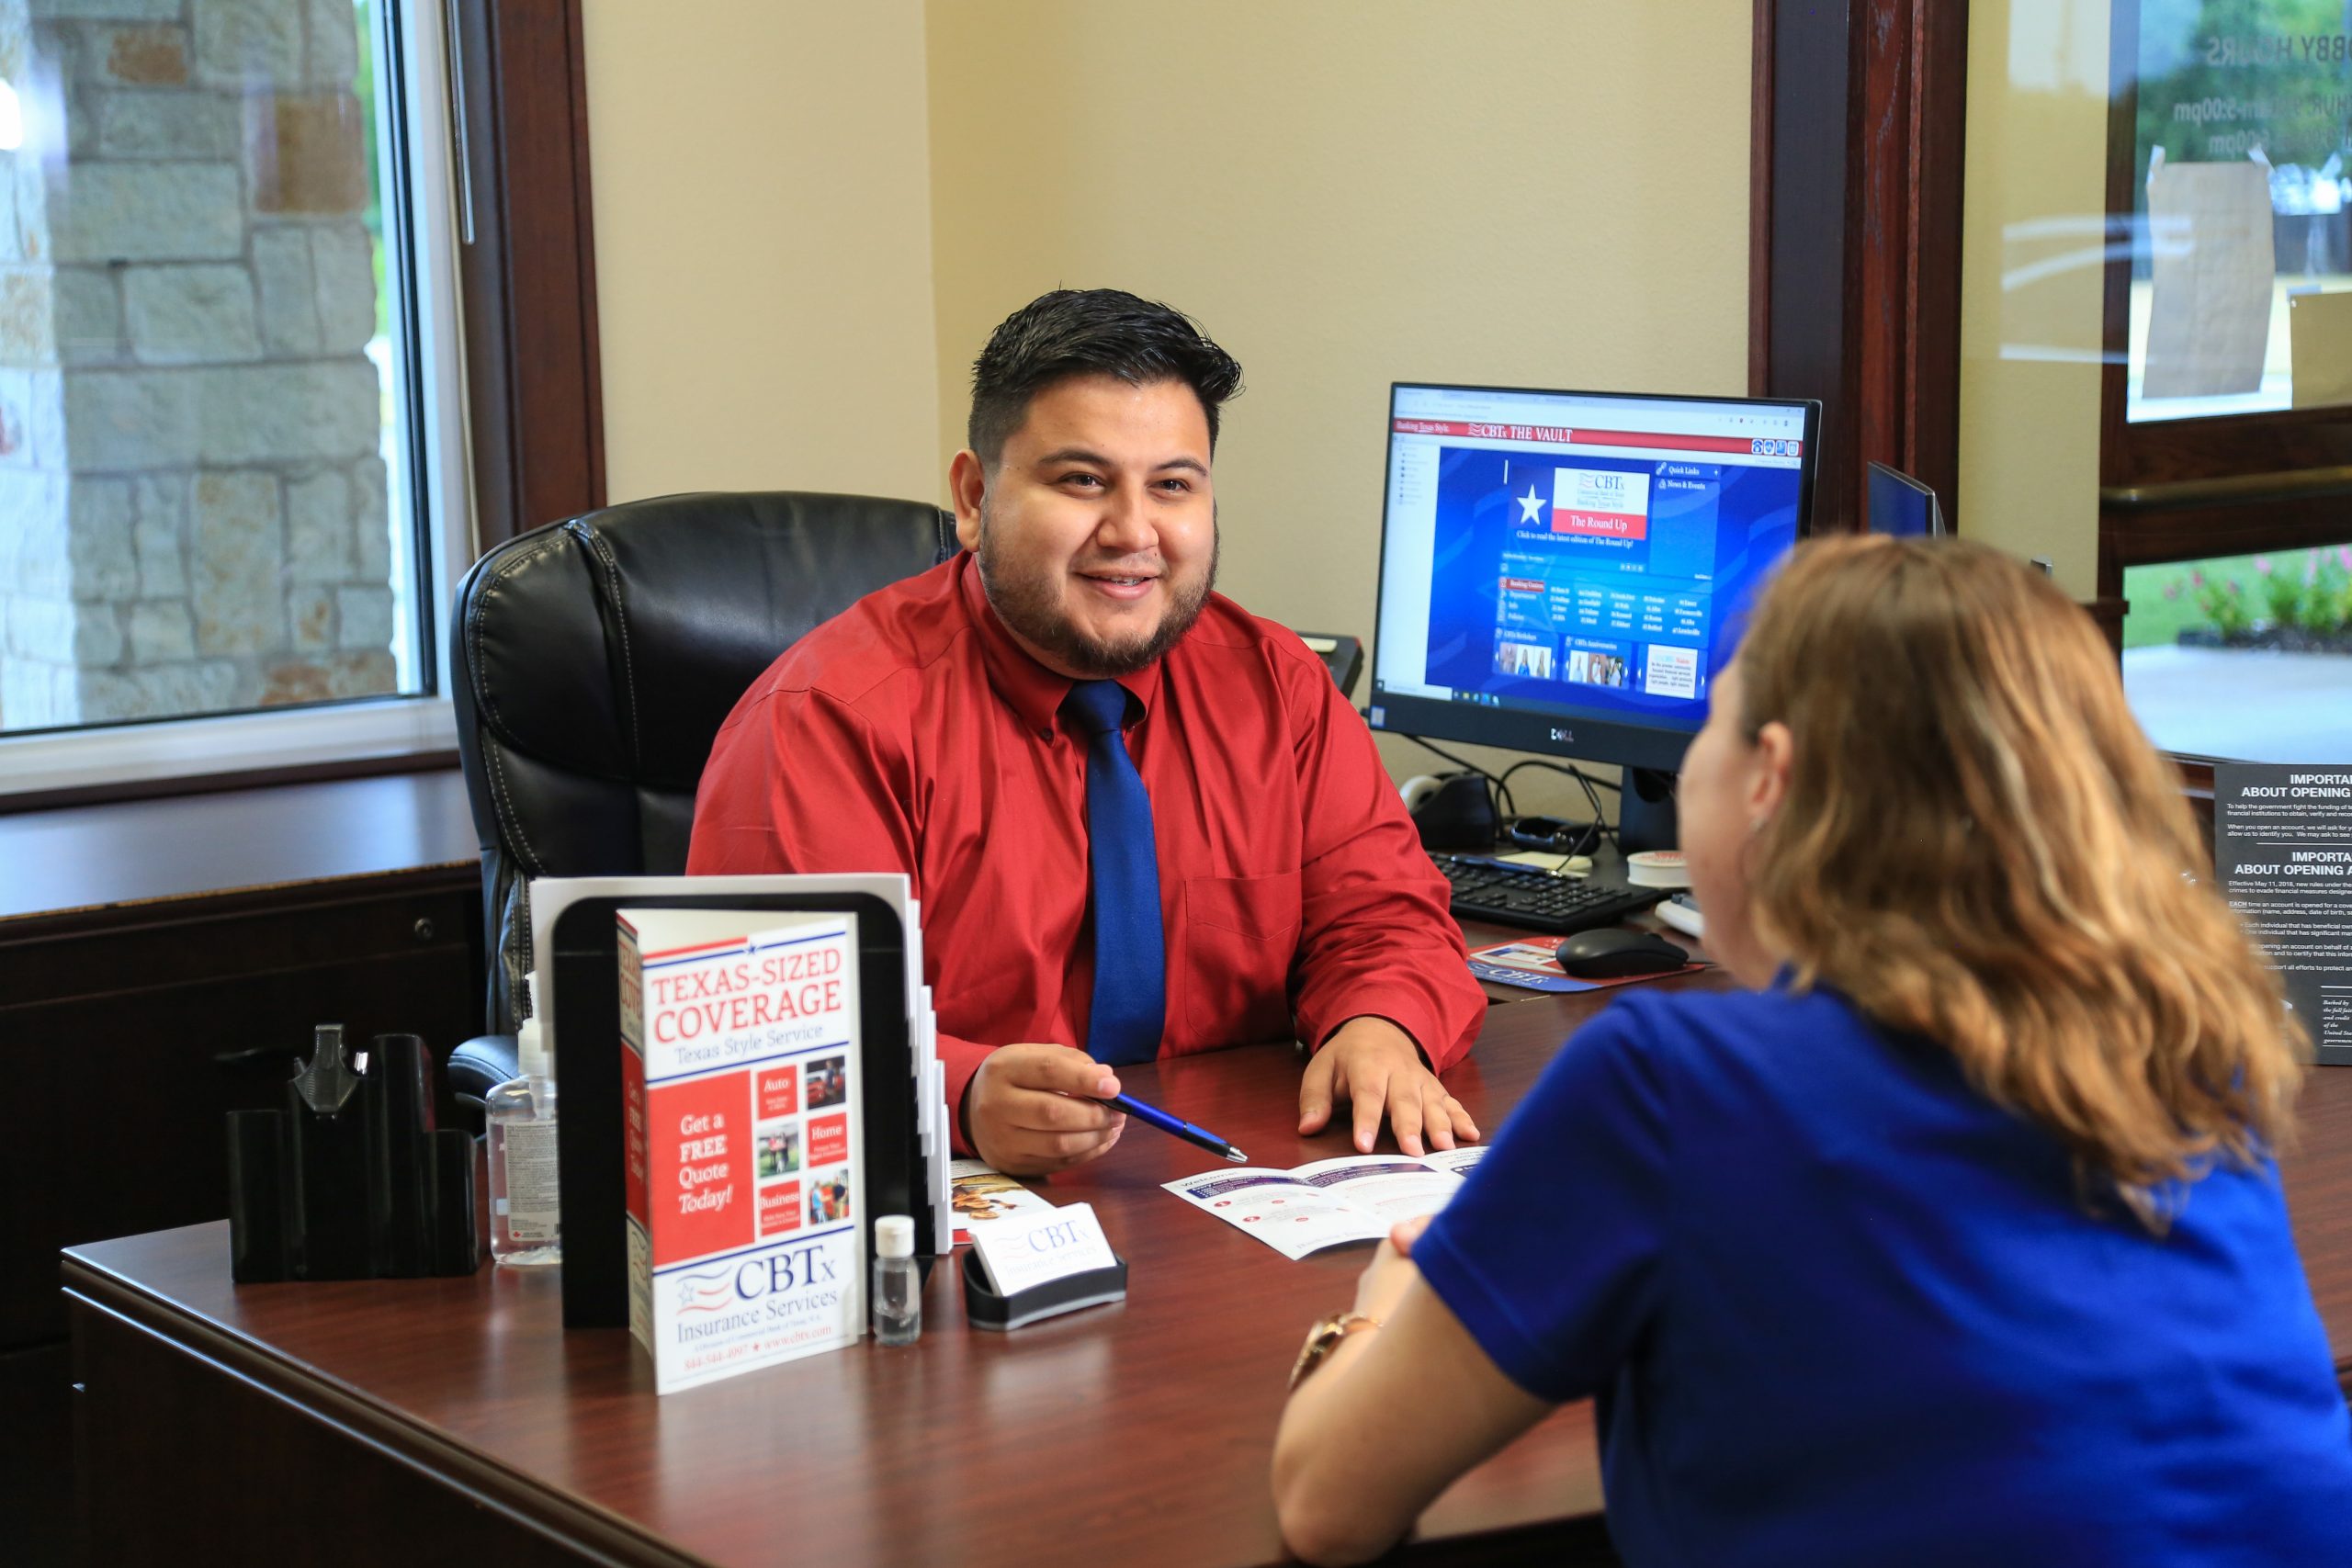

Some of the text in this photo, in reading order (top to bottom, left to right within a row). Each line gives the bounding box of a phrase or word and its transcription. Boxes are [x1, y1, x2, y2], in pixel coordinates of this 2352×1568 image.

[1510, 425, 1533, 441] THE
[1535, 427, 1573, 443] VAULT
[1668, 466, 1700, 476] Quick Links
[1668, 479, 1681, 489] News
[1688, 482, 1706, 491] Events
[1570, 514, 1628, 534] The Round Up
[1517, 530, 1529, 539] Click
[1530, 532, 1536, 540] to
[1537, 532, 1548, 541] read
[1571, 535, 1588, 544] edition
[1589, 536, 1594, 545] of
[1595, 536, 1605, 546] The
[1605, 537, 1623, 547] Round
[2290, 773, 2352, 784] IMPORTA
[2241, 786, 2351, 797] ABOUT OPENING
[2292, 852, 2352, 863] IMPORTA
[2234, 864, 2344, 875] ABOUT OPENING
[651, 948, 842, 1007] TEXAS-SIZED
[653, 979, 842, 1044] COVERAGE
[674, 1023, 824, 1066] Texas Style Service
[763, 1077, 790, 1093] Auto
[680, 1112, 725, 1136] Get a
[811, 1124, 842, 1141] Home
[679, 1134, 729, 1164] FREE
[678, 1162, 729, 1190] Quote
[678, 1184, 734, 1214] Today!
[759, 1190, 801, 1211] Business
[734, 1244, 837, 1302] CBTx
[676, 1309, 761, 1344] Insurance
[765, 1290, 839, 1321] Services
